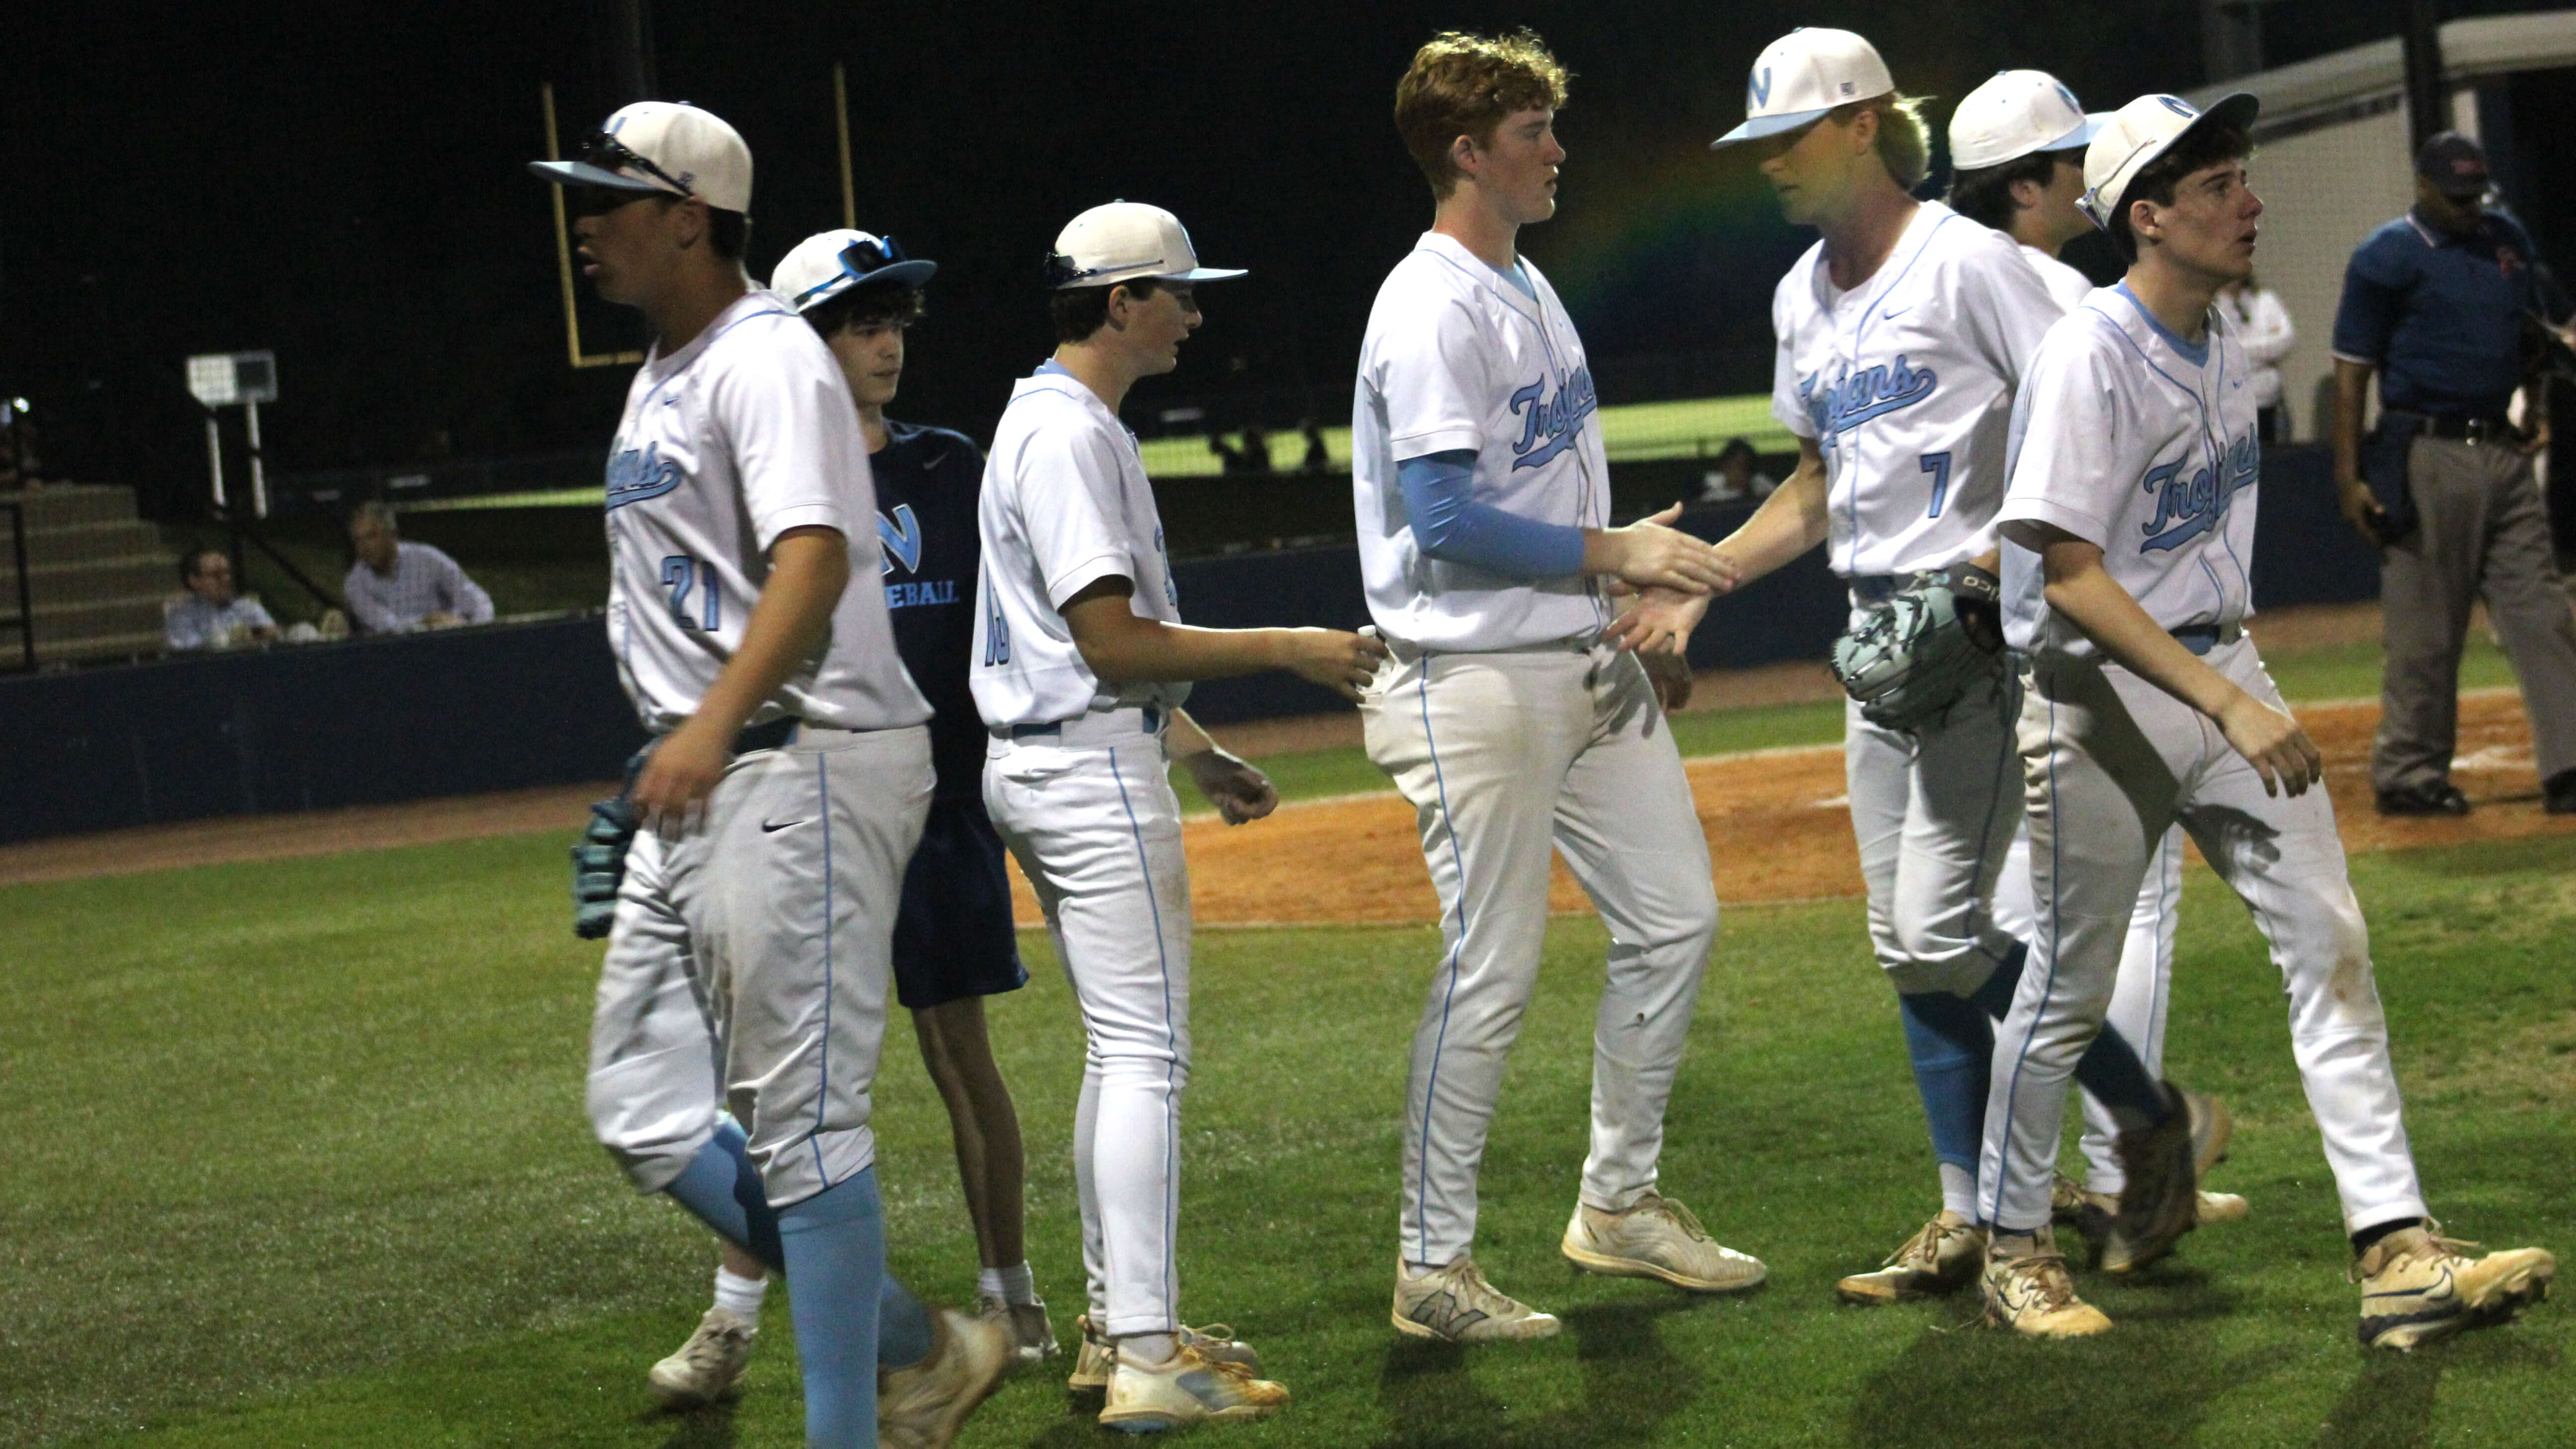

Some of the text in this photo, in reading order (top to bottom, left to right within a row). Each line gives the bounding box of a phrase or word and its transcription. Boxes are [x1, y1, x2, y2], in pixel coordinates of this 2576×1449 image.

[1800, 354, 1937, 447] ojans
[1920, 451, 1951, 518] 7
[662, 555, 719, 631] 21
[884, 580, 960, 609] EBALL
